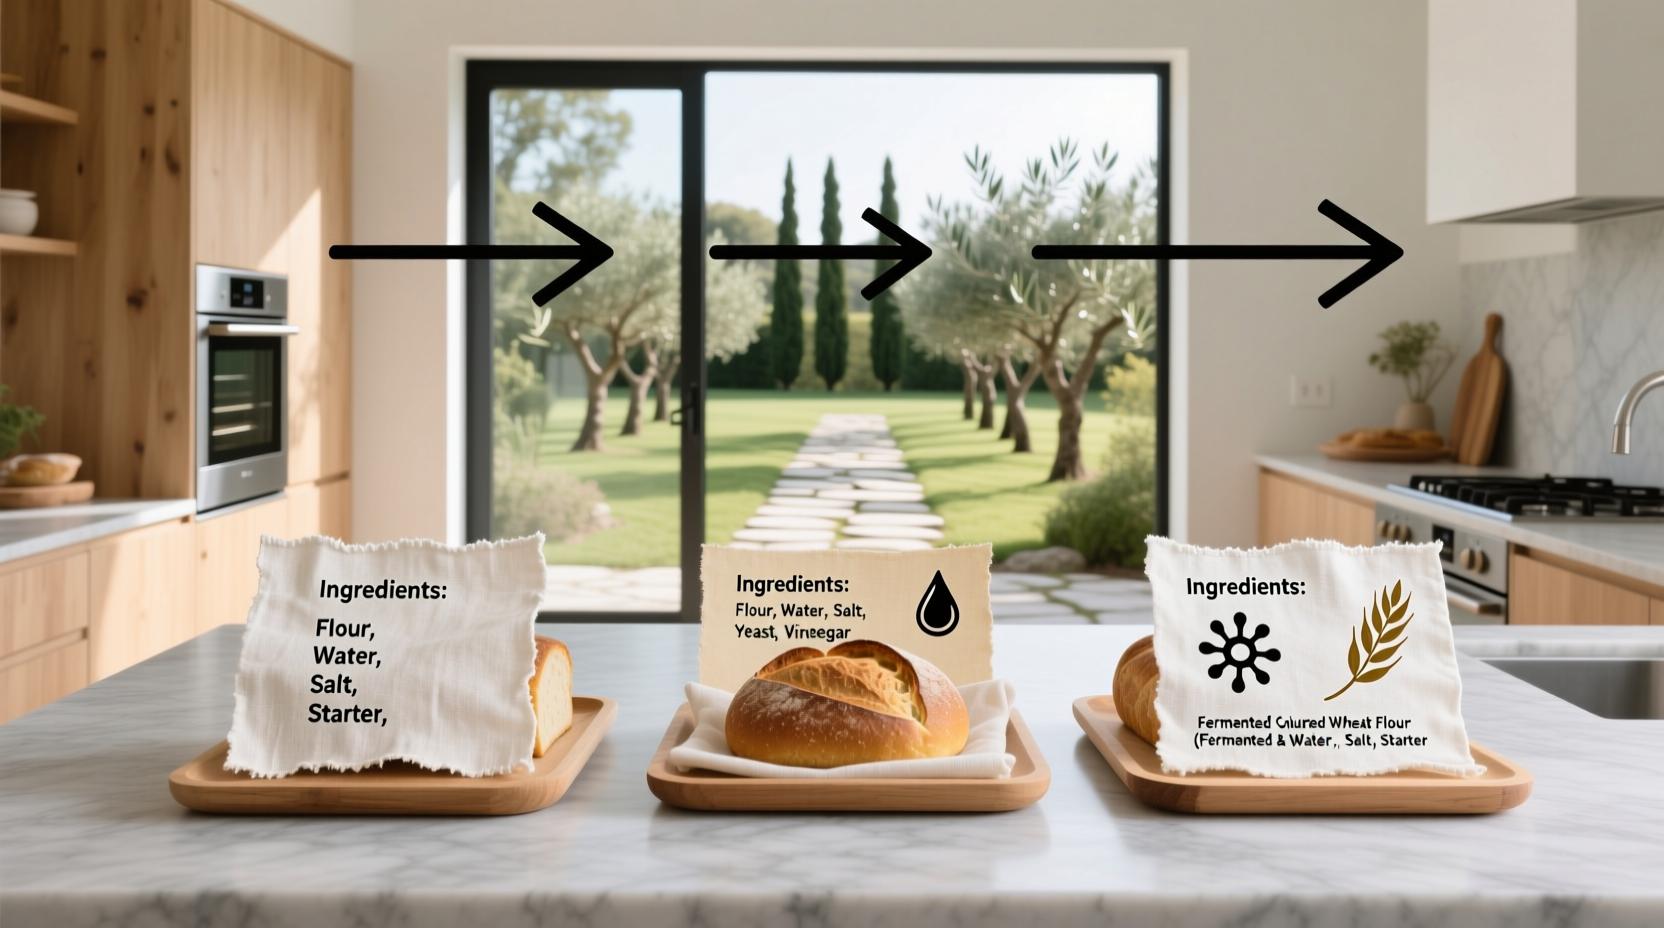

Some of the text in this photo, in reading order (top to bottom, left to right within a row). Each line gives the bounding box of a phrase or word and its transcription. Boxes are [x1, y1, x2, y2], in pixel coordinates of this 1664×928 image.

[319, 578, 447, 604] Ingredients:
[736, 574, 849, 598] Ingredients:
[1186, 576, 1306, 601] Ingredients:
[735, 602, 866, 621] Flour, Water, Salt,
[315, 617, 375, 642] Flour,
[734, 623, 779, 642] Yeast,
[313, 645, 382, 669] Water,
[310, 673, 358, 698] Salt,
[307, 702, 388, 728] Starter,
[1375, 715, 1412, 729] Flour
[1344, 733, 1377, 751] Salt,
[1380, 733, 1428, 747] Starter
